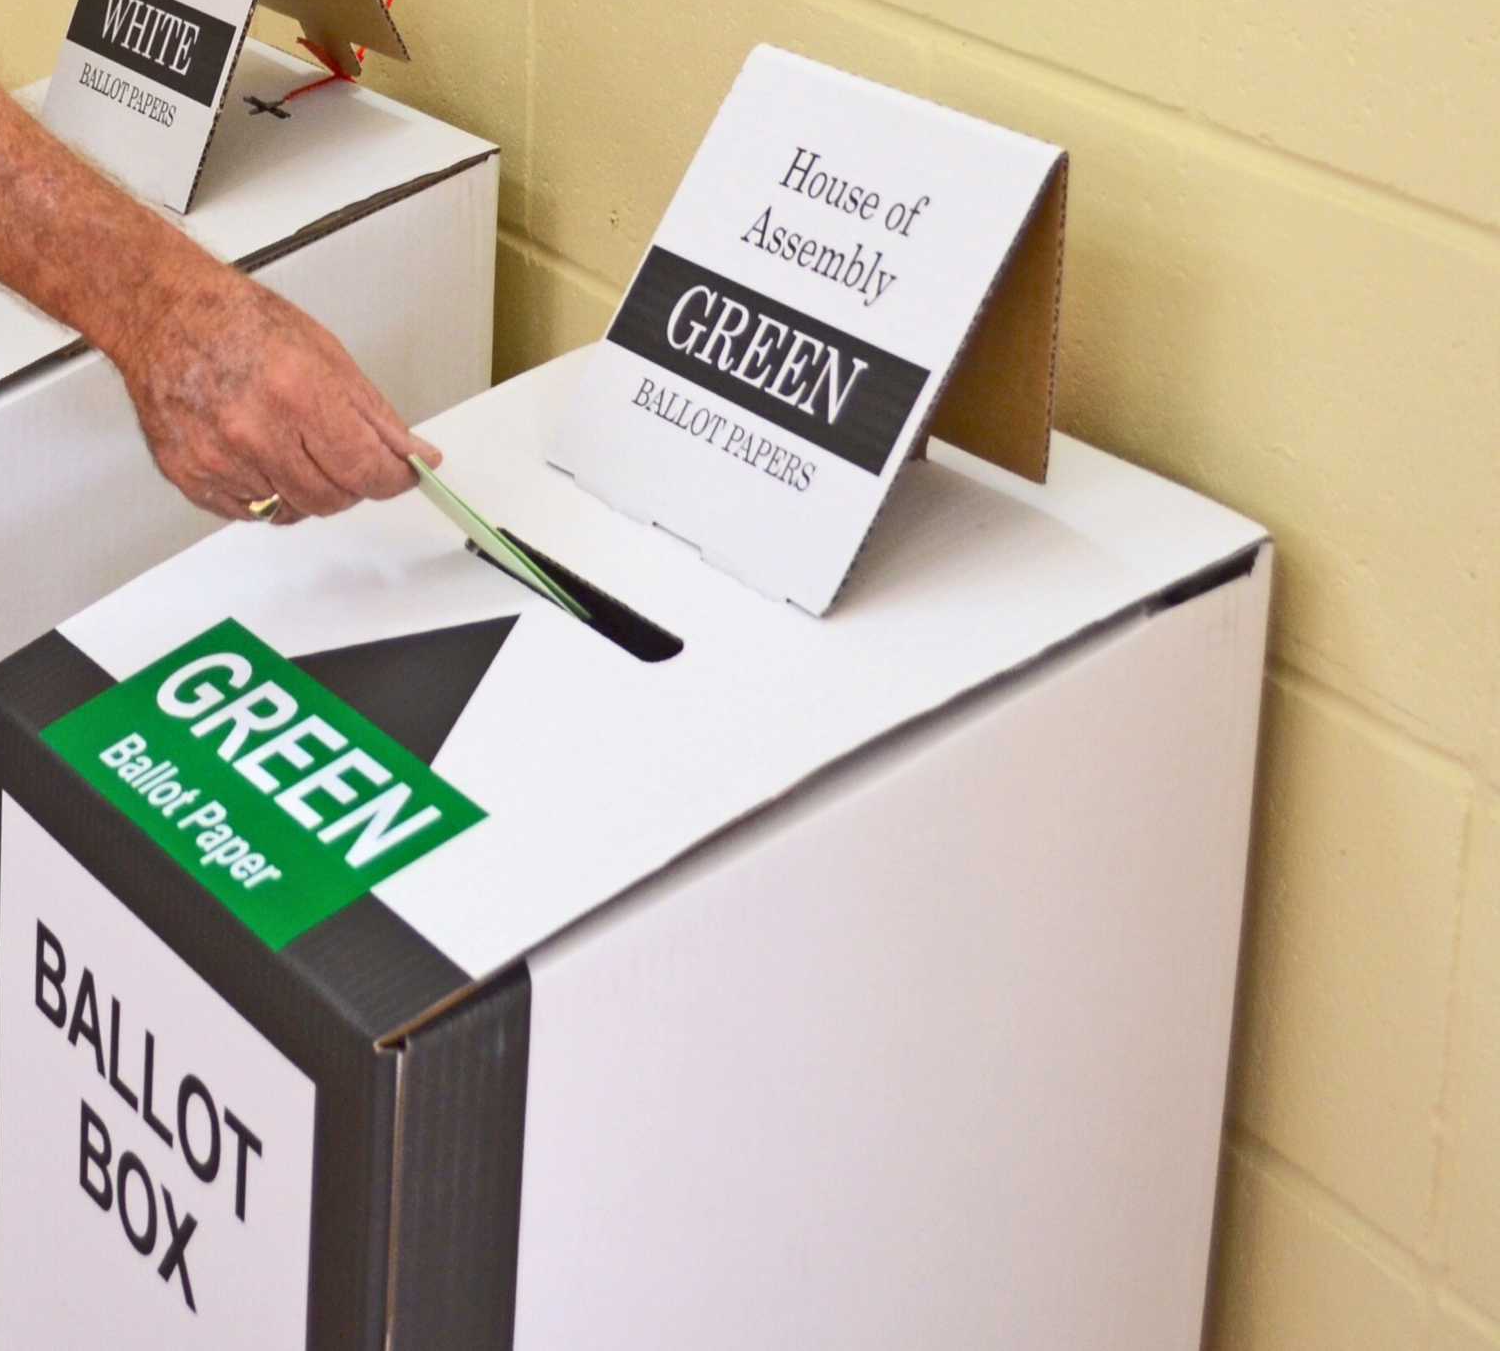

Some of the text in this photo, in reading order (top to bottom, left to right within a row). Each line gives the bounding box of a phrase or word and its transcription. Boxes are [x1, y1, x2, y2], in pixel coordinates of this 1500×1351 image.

[79, 63, 177, 128] BALLOT PAPERS
[740, 205, 897, 308] Assembly
[779, 147, 930, 237] House of
[666, 285, 867, 426] GREEN
[631, 378, 817, 492] BALLOT PAPERS
[99, 732, 282, 889] Ballot Paper
[156, 652, 442, 870] GREEN
[36, 917, 263, 1223] BALLOT
[80, 1098, 198, 1314] BOX
